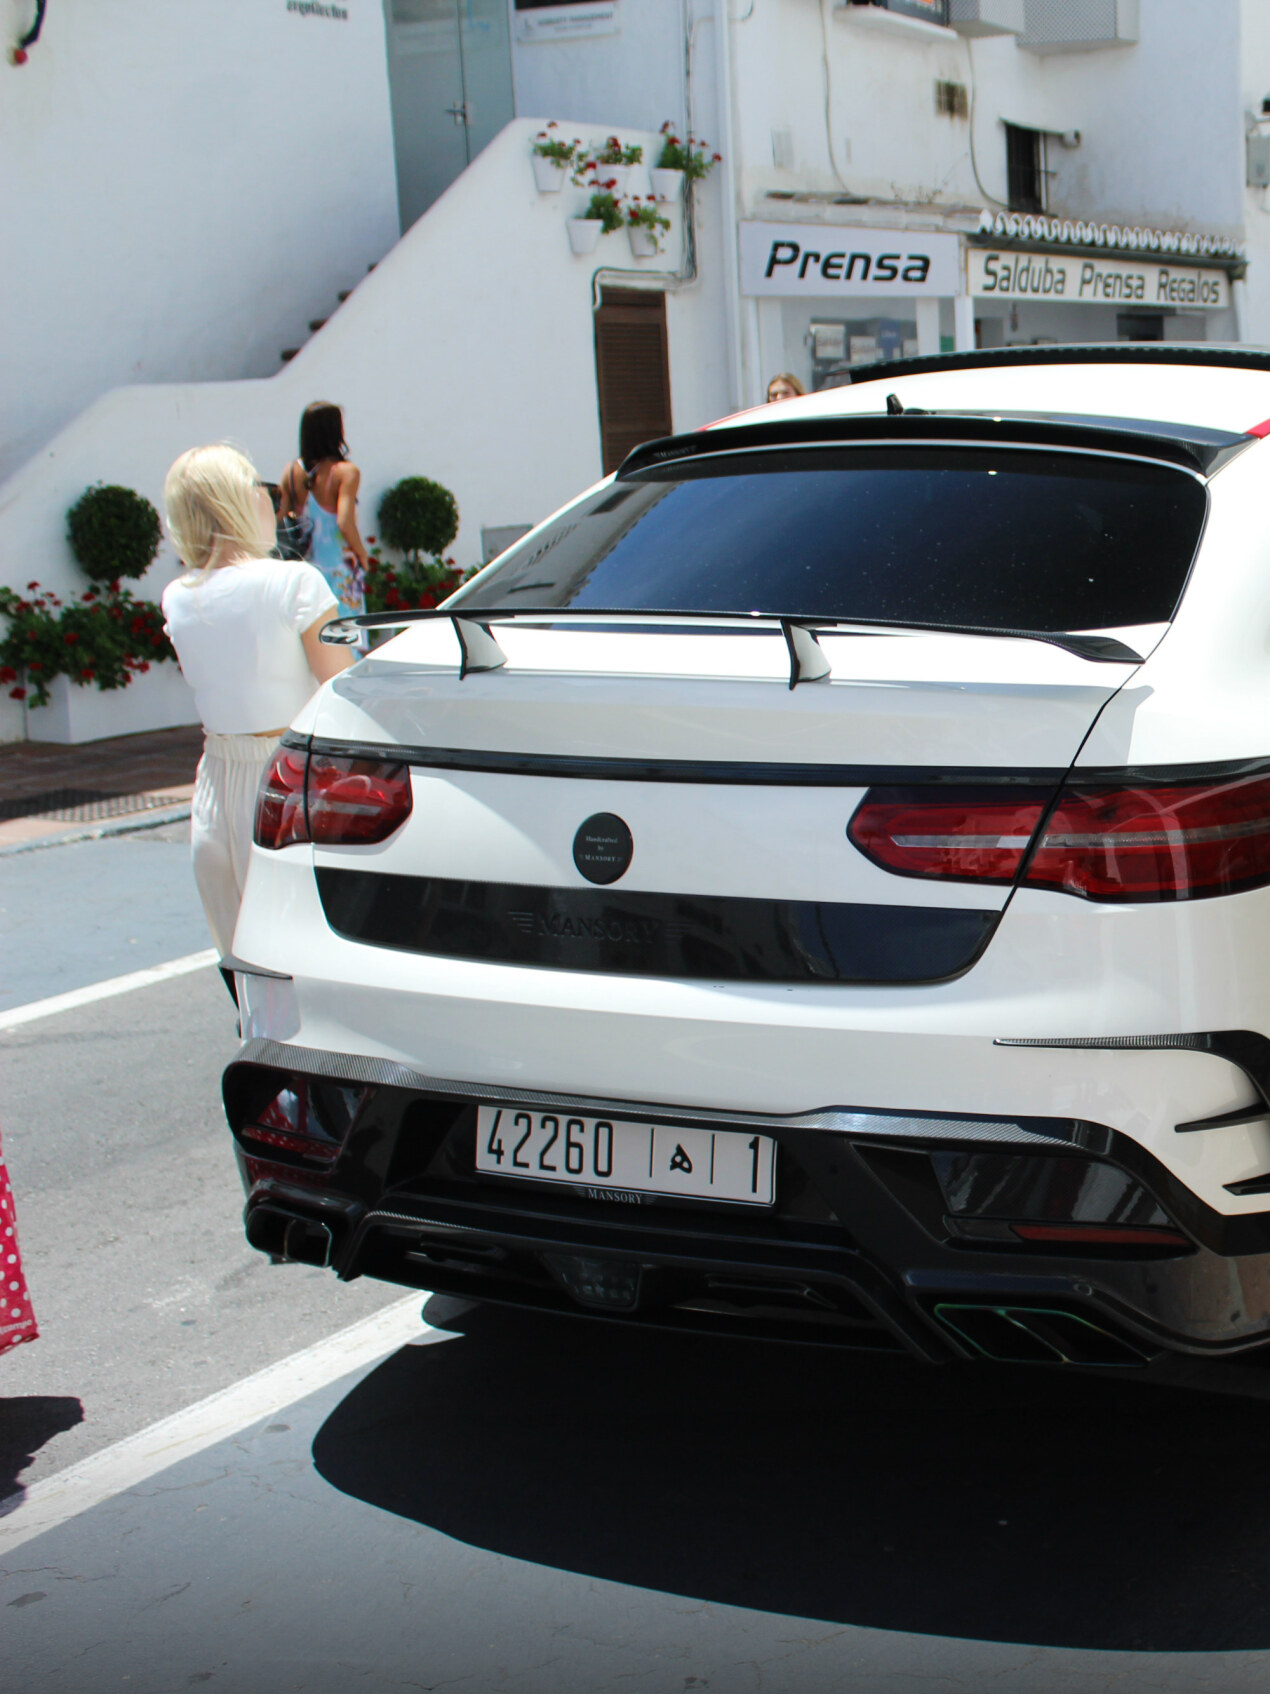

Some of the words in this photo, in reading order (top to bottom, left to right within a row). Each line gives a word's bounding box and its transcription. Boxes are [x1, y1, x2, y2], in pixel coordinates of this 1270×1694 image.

[764, 240, 931, 282] Prensa
[982, 253, 1067, 295] Salduba
[1078, 262, 1146, 299] Prensa
[1157, 268, 1220, 304] Regalos
[536, 912, 659, 944] MANSORY
[487, 1109, 614, 1178] 42260
[748, 1136, 761, 1193] 1
[588, 1188, 643, 1205] MANSORY
